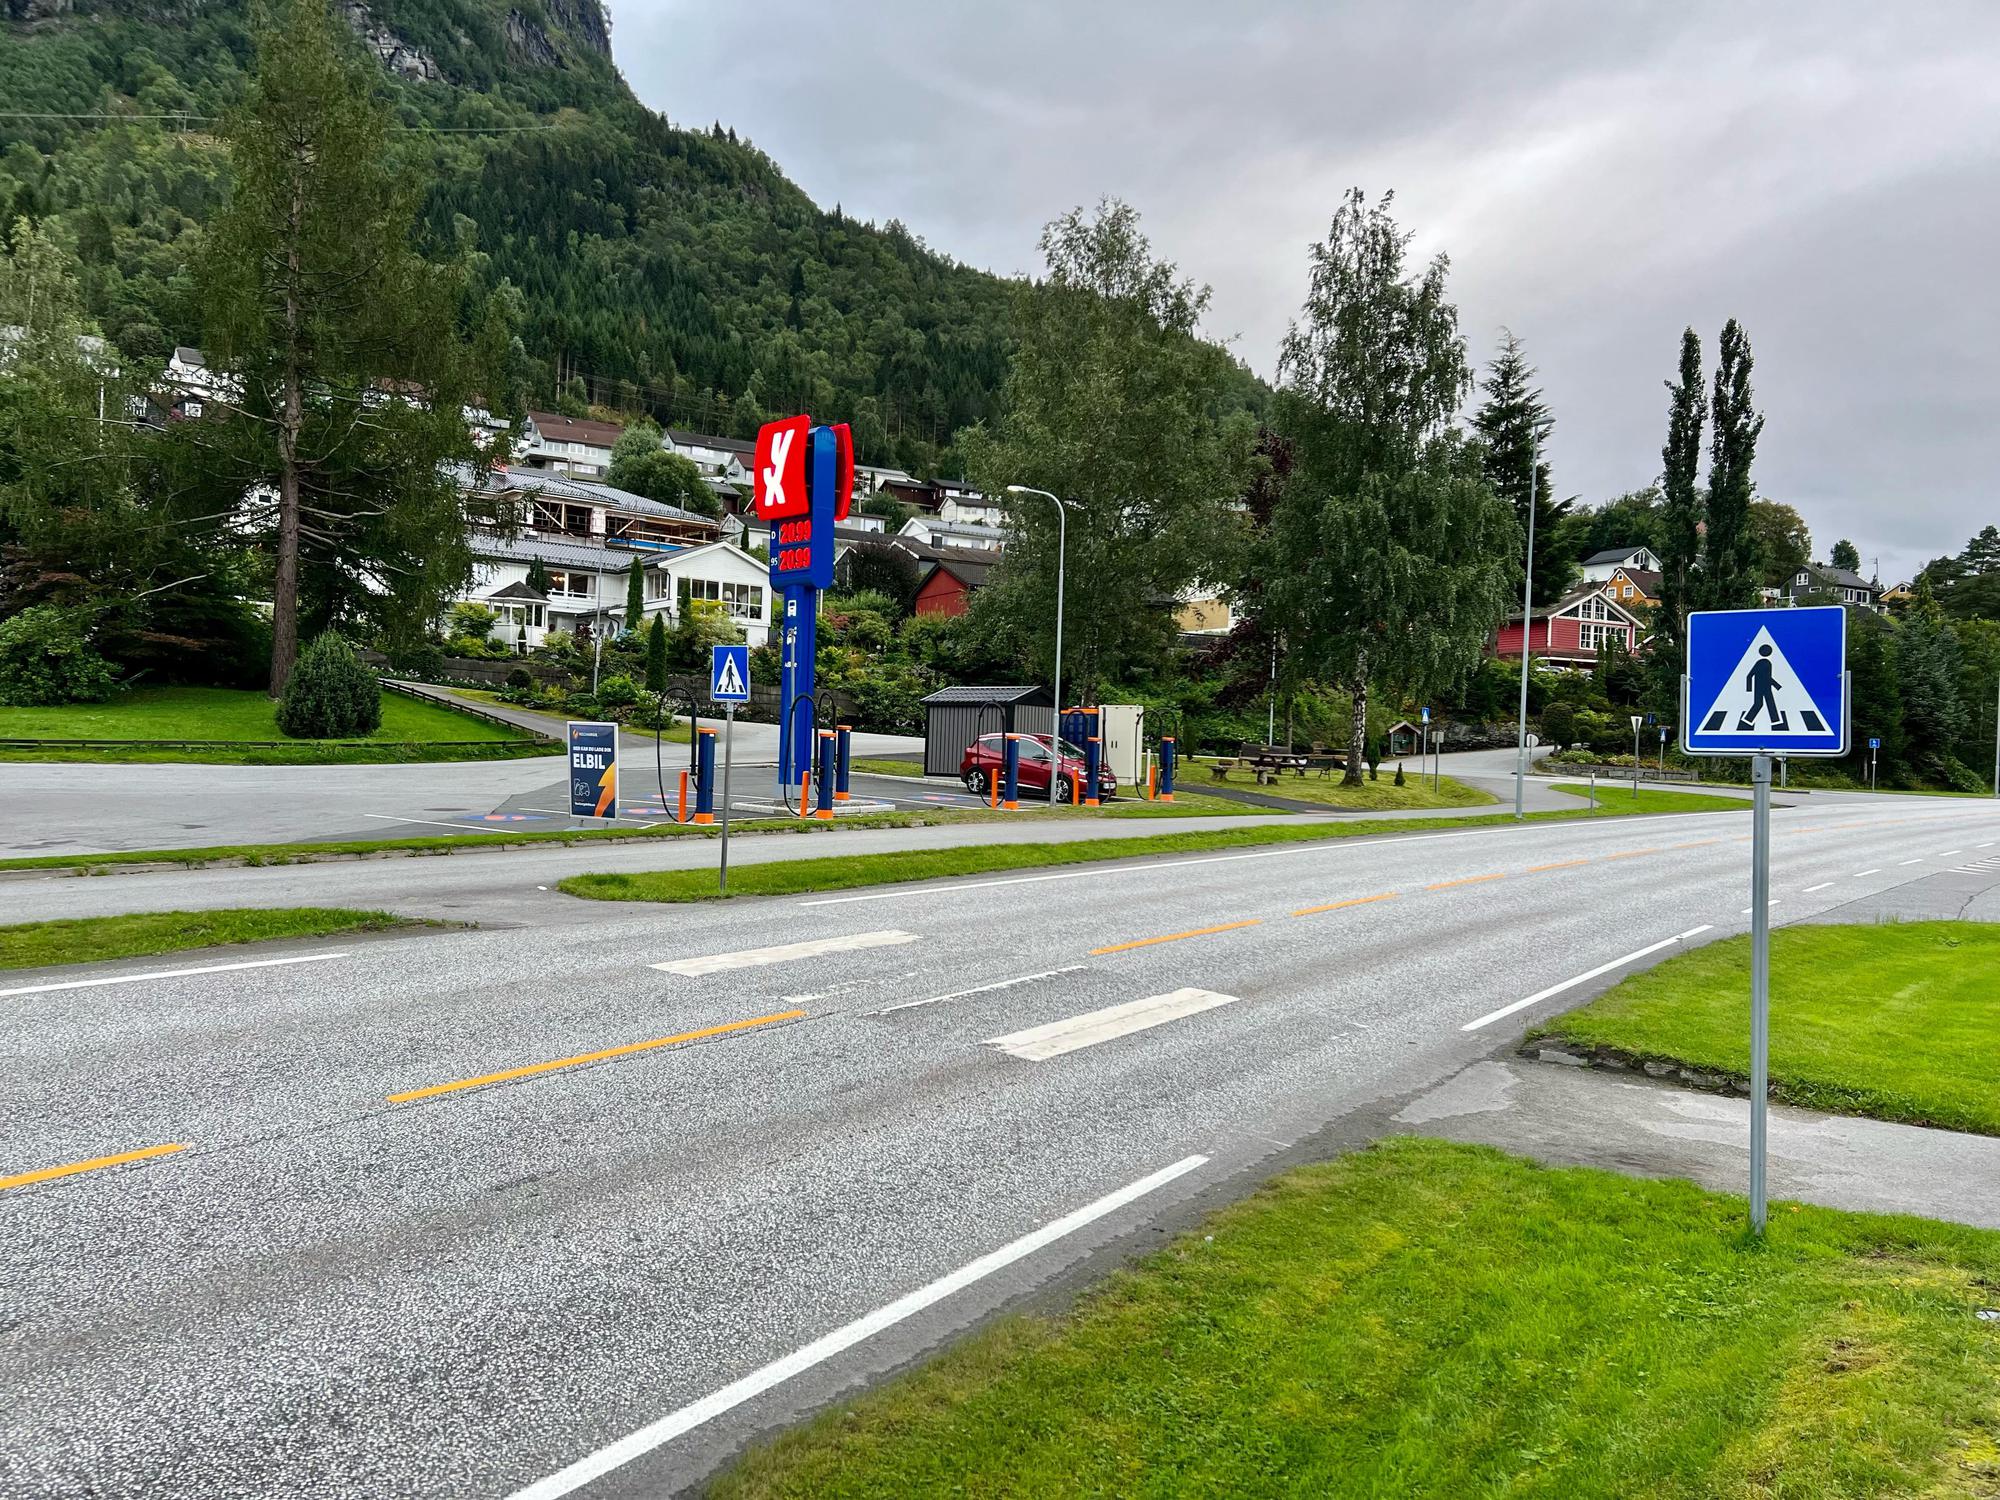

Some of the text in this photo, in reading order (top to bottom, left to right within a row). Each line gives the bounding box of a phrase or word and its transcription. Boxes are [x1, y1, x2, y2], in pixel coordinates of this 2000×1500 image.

[770, 547, 811, 571] 95 20.99
[573, 753, 605, 769] ELBIL
